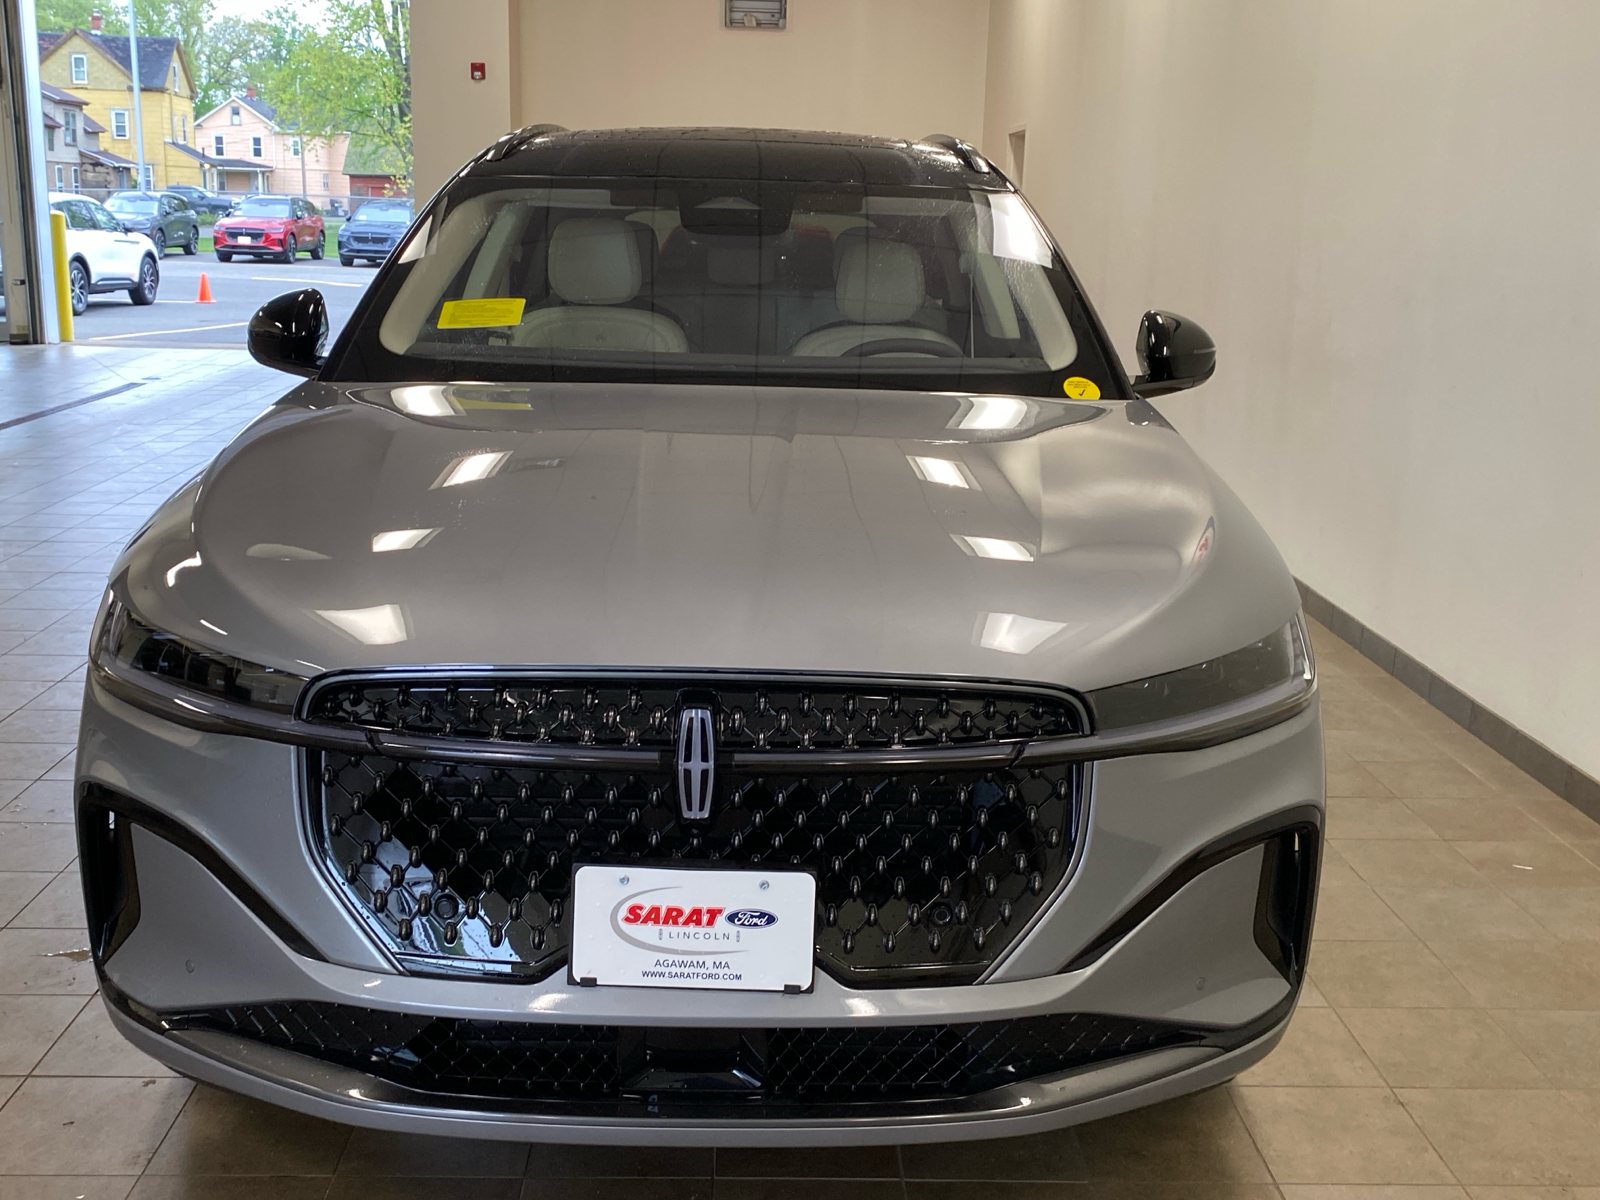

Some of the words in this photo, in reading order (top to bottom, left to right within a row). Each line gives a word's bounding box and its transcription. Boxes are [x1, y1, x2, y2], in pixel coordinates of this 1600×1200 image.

[621, 903, 726, 928] SARAT
[734, 911, 768, 926] Ford
[668, 931, 730, 941] LINCOLN
[653, 959, 709, 970] AGAWAM,
[712, 961, 731, 970] MA
[641, 970, 743, 981] WWW.SARATFORD.COM
